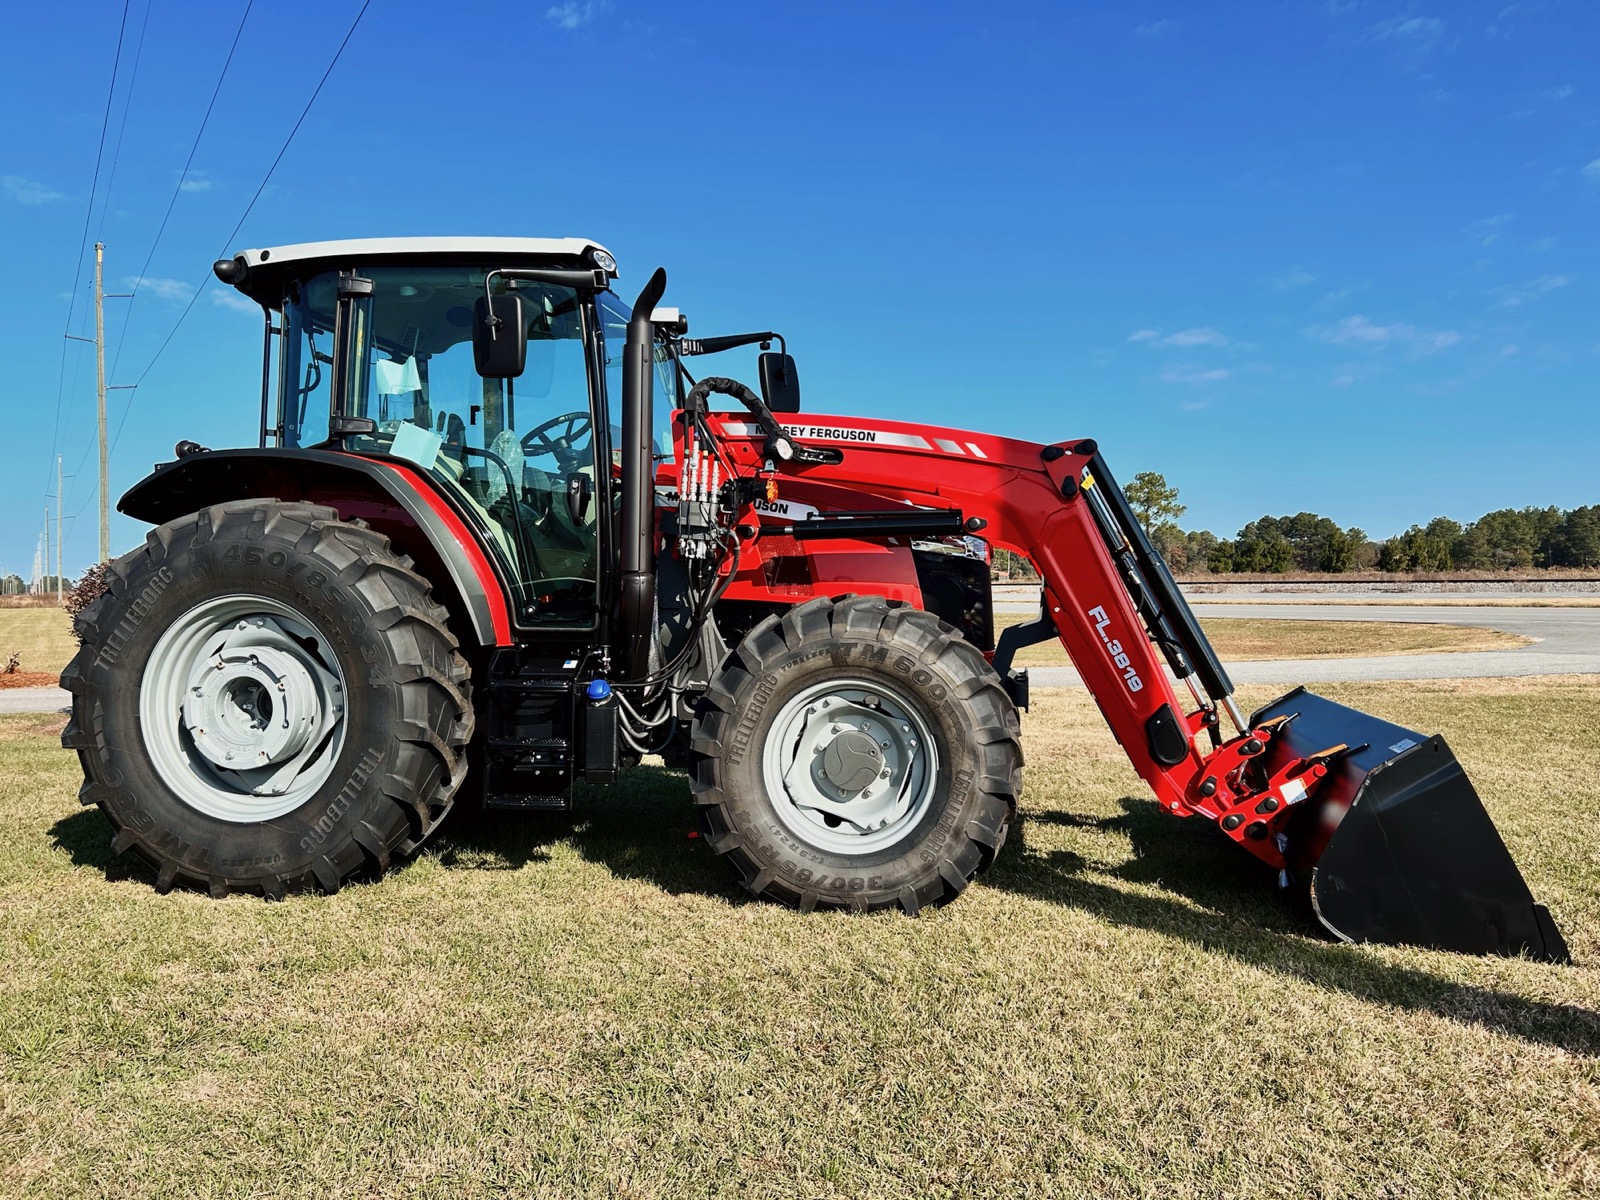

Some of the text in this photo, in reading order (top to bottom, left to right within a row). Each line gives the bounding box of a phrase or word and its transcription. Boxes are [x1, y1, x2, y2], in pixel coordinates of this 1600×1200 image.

[755, 425, 876, 442] MSEY FERGUSON
[754, 500, 788, 514] USON
[94, 566, 174, 670] TRELLEBORG
[1088, 605, 1144, 692] FL.3819
[725, 671, 778, 765] TRELLEBORG
[300, 746, 386, 854] TRELLEBORG
[920, 768, 976, 864] TRELLEBORG
[779, 859, 884, 891] 380/85
